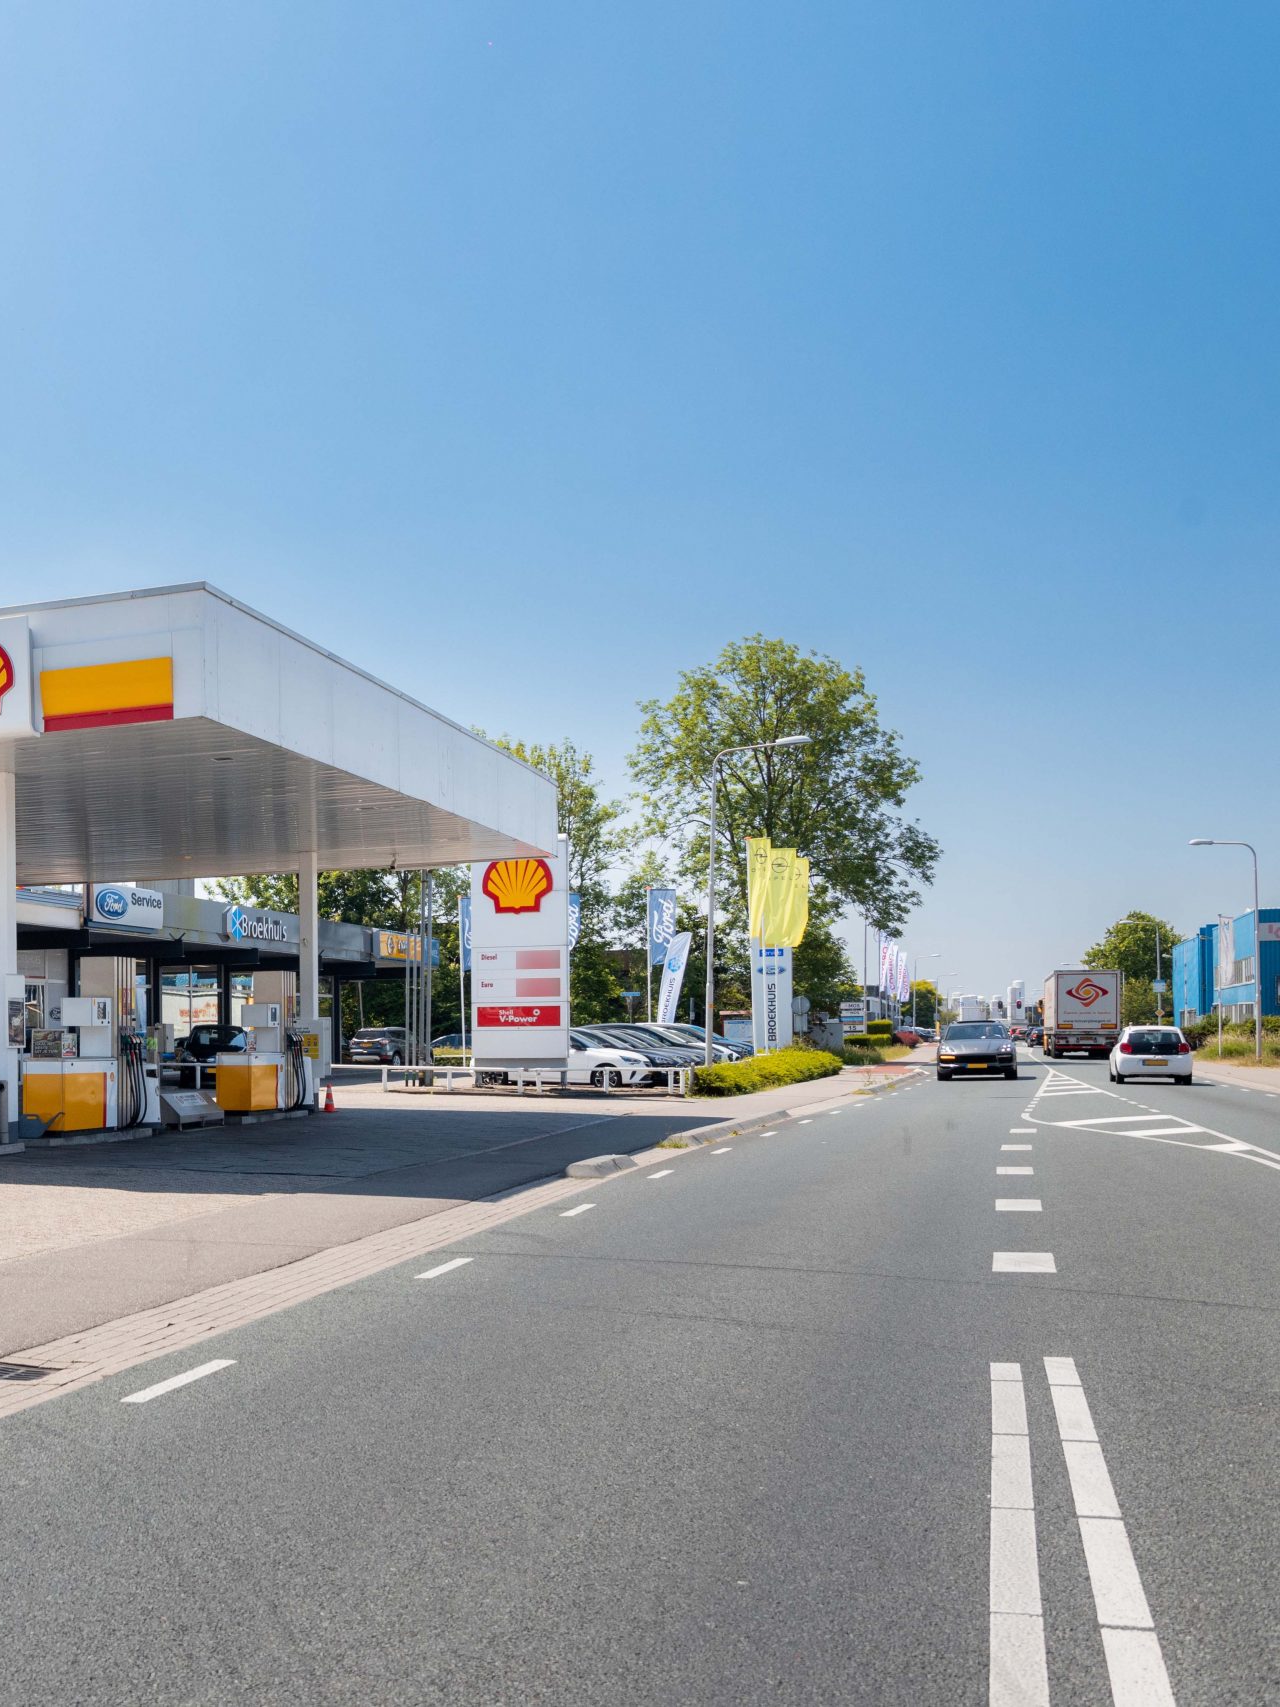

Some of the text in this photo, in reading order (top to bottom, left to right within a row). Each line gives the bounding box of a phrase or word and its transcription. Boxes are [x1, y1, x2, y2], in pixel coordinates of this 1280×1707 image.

[104, 892, 162, 913] Ford Service
[242, 916, 287, 942] Broekhuis
[653, 899, 674, 947] Ford
[499, 1015, 538, 1023] V-Power
[767, 983, 776, 1041] BROEKHUIS
